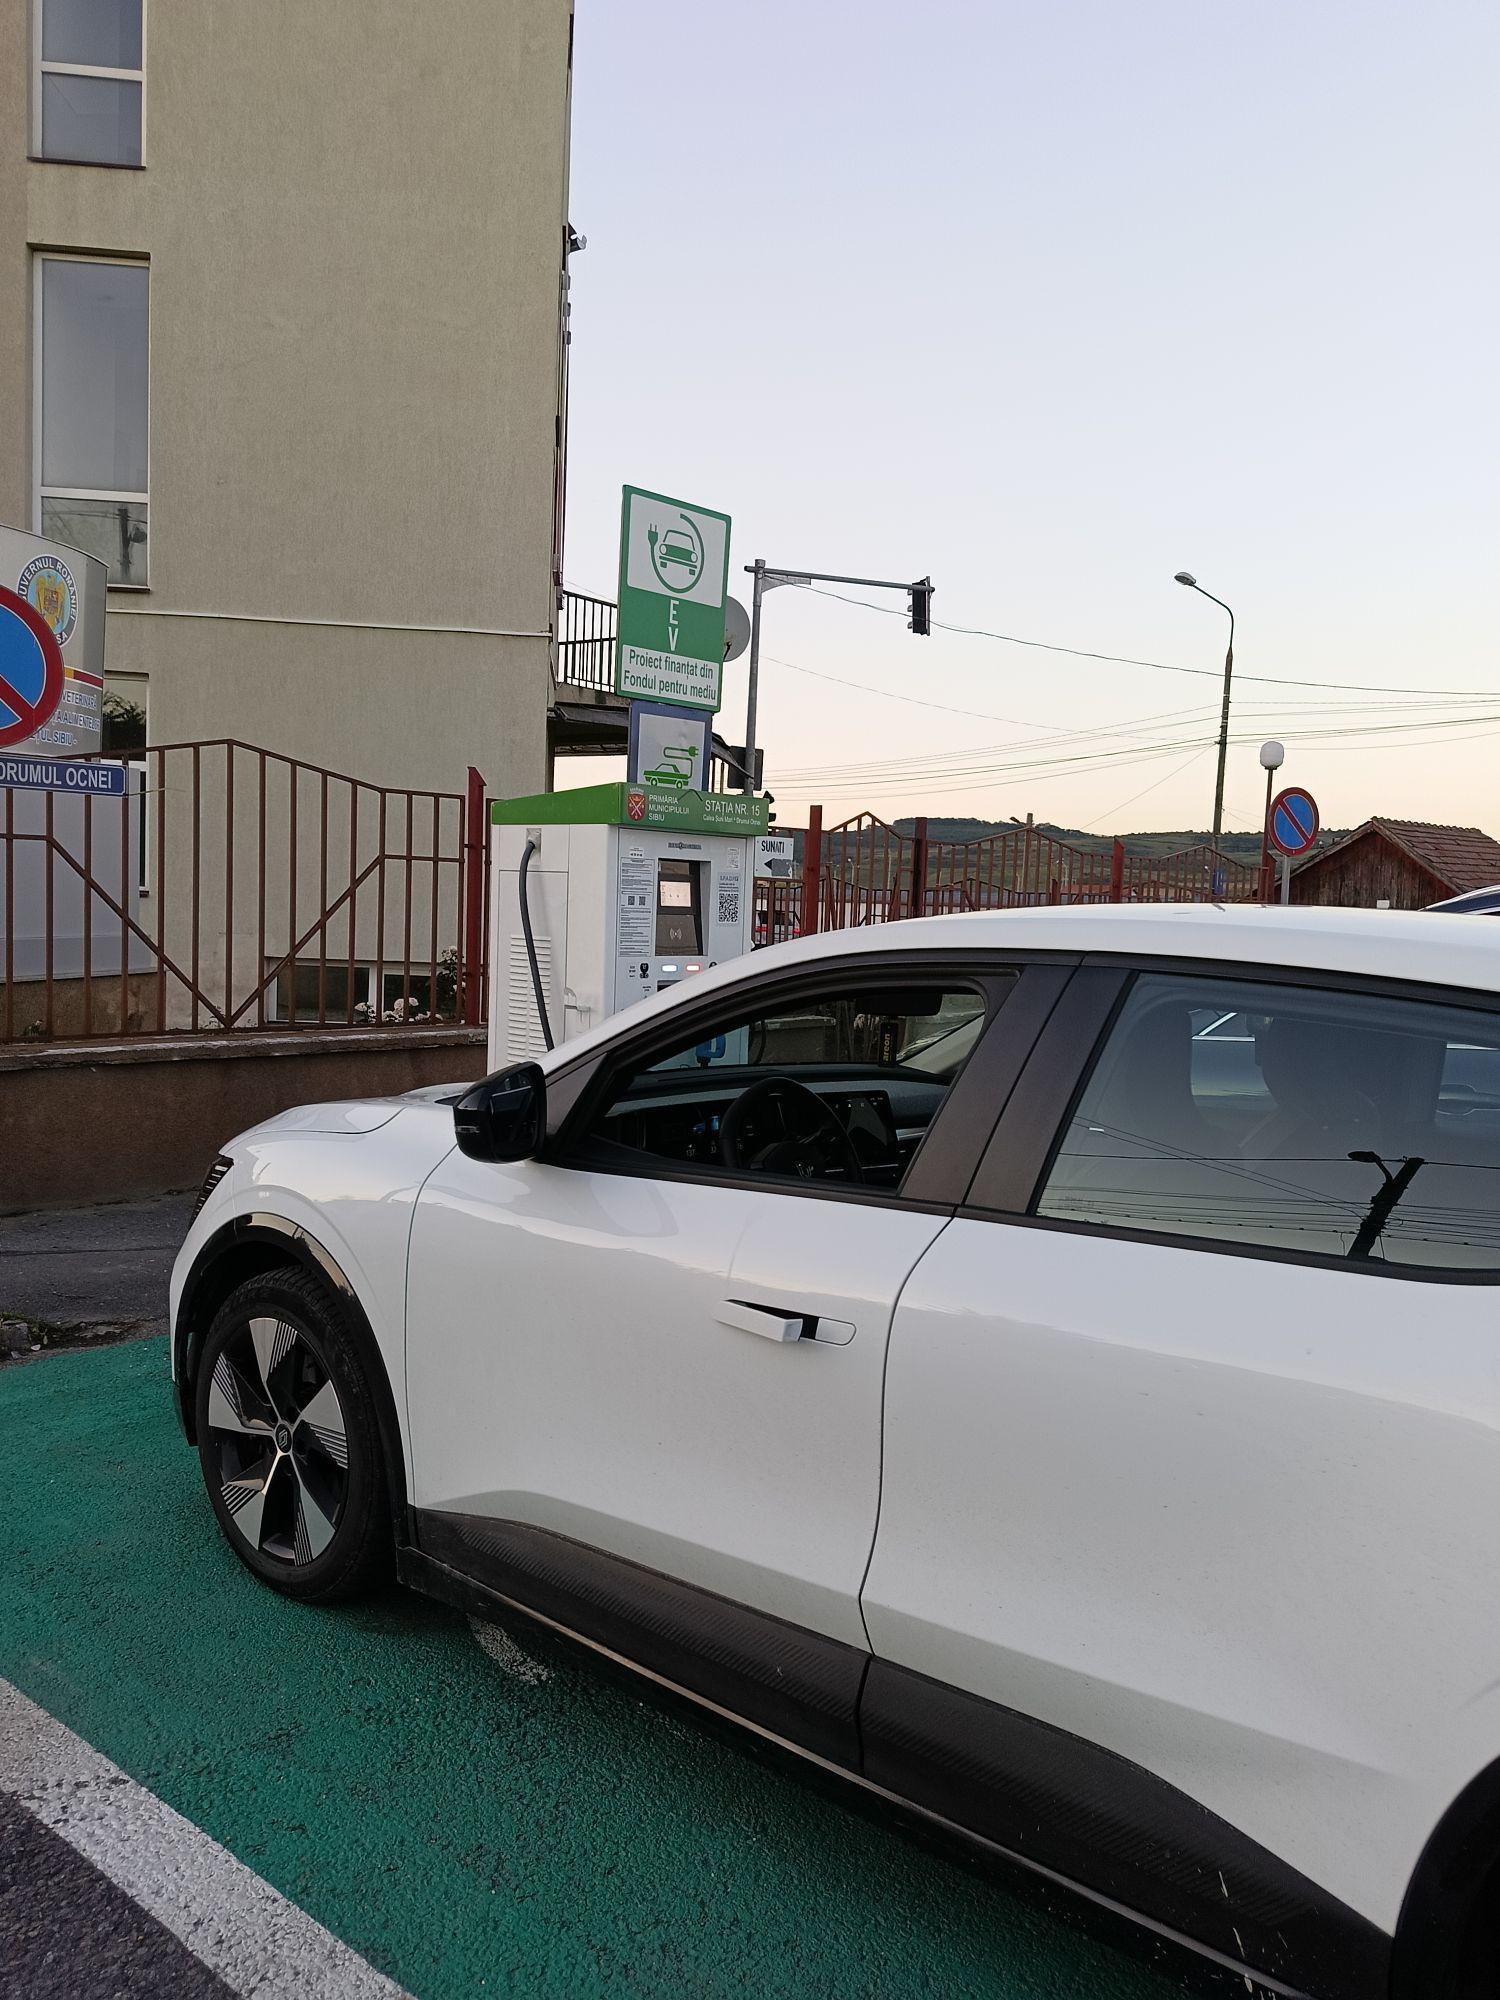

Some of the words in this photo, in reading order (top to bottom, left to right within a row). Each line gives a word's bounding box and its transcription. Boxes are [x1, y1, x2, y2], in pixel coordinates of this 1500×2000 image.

[629, 649, 662, 670] Proiect
[664, 656, 698, 679] finanțat
[699, 664, 714, 680] din
[623, 670, 657, 690] Fondul
[658, 679, 688, 695] pentru
[690, 684, 717, 700] mediu
[53, 730, 73, 746] SIBIU
[66, 767, 112, 789] OCNEI
[648, 812, 665, 822] SIBIU
[735, 803, 749, 815] NR.
[751, 804, 760, 817] 15
